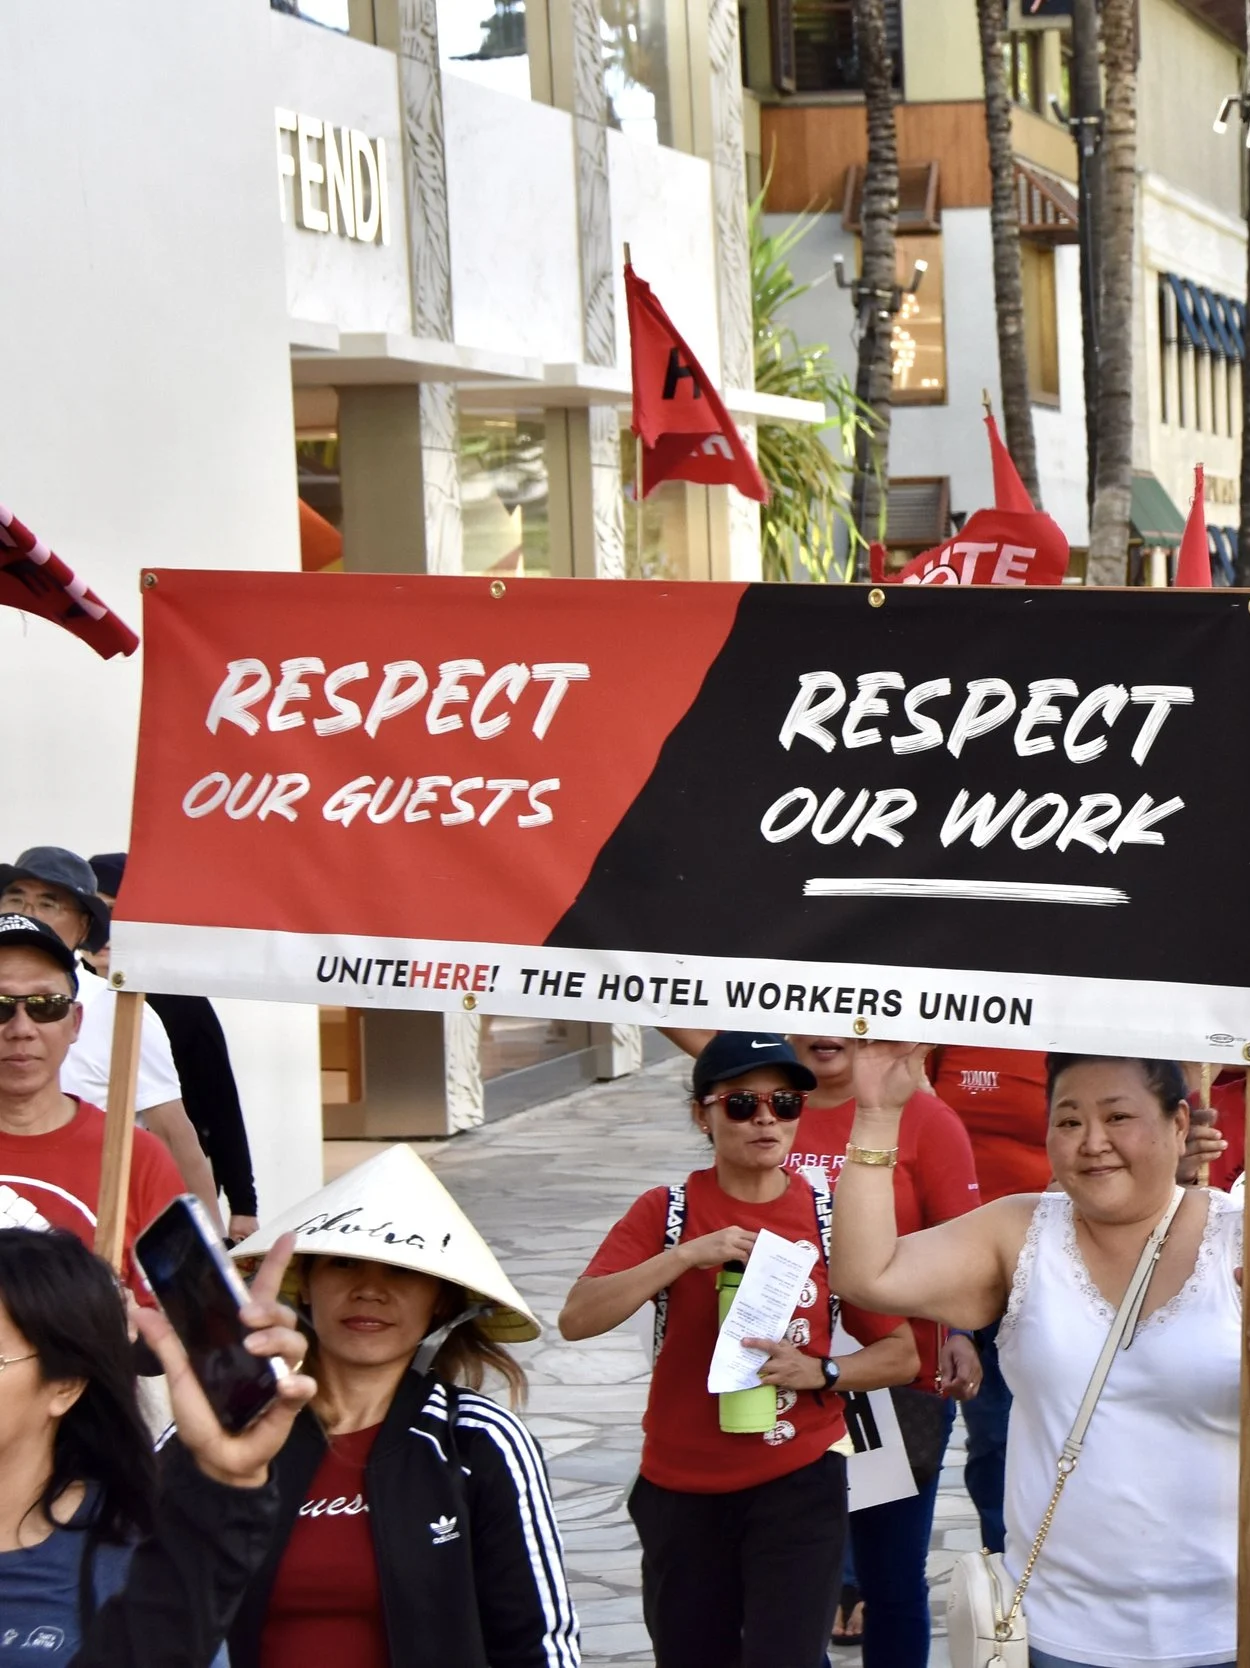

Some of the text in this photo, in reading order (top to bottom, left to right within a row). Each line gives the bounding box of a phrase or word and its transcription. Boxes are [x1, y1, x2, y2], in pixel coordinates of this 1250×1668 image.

[275, 106, 391, 246] FENDI
[903, 542, 1037, 586] ITE
[205, 656, 591, 741] RESPECT
[779, 670, 1195, 767] RESPECT
[182, 771, 561, 828] OUR GUESTS
[760, 786, 1186, 855] OUR WORK
[316, 955, 1034, 1027] UNITEHERE! THE HOTEL WORKERS UNION
[960, 1070, 1000, 1087] TOMMY
[298, 1493, 370, 1517] ues
[432, 1531, 461, 1545] adidas
